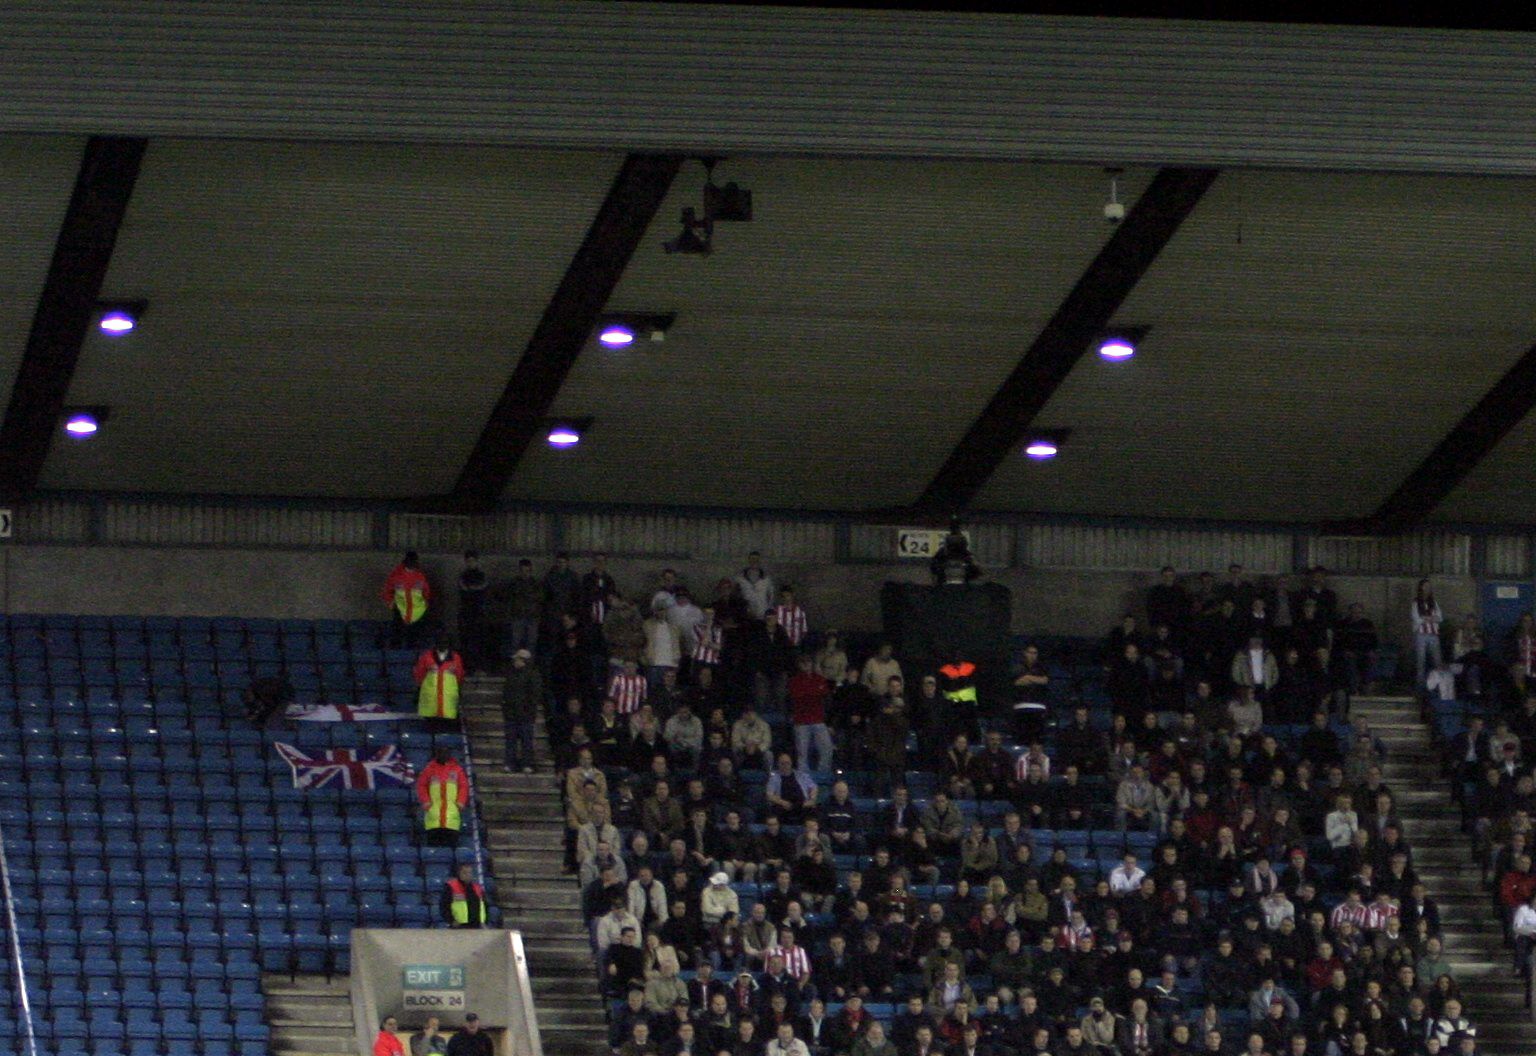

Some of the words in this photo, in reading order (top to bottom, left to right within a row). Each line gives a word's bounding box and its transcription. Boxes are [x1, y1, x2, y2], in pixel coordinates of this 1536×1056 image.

[910, 541, 930, 554] 24
[407, 970, 441, 984] EXIT
[406, 996, 443, 1006] BLOCK
[449, 996, 463, 1006] 24
